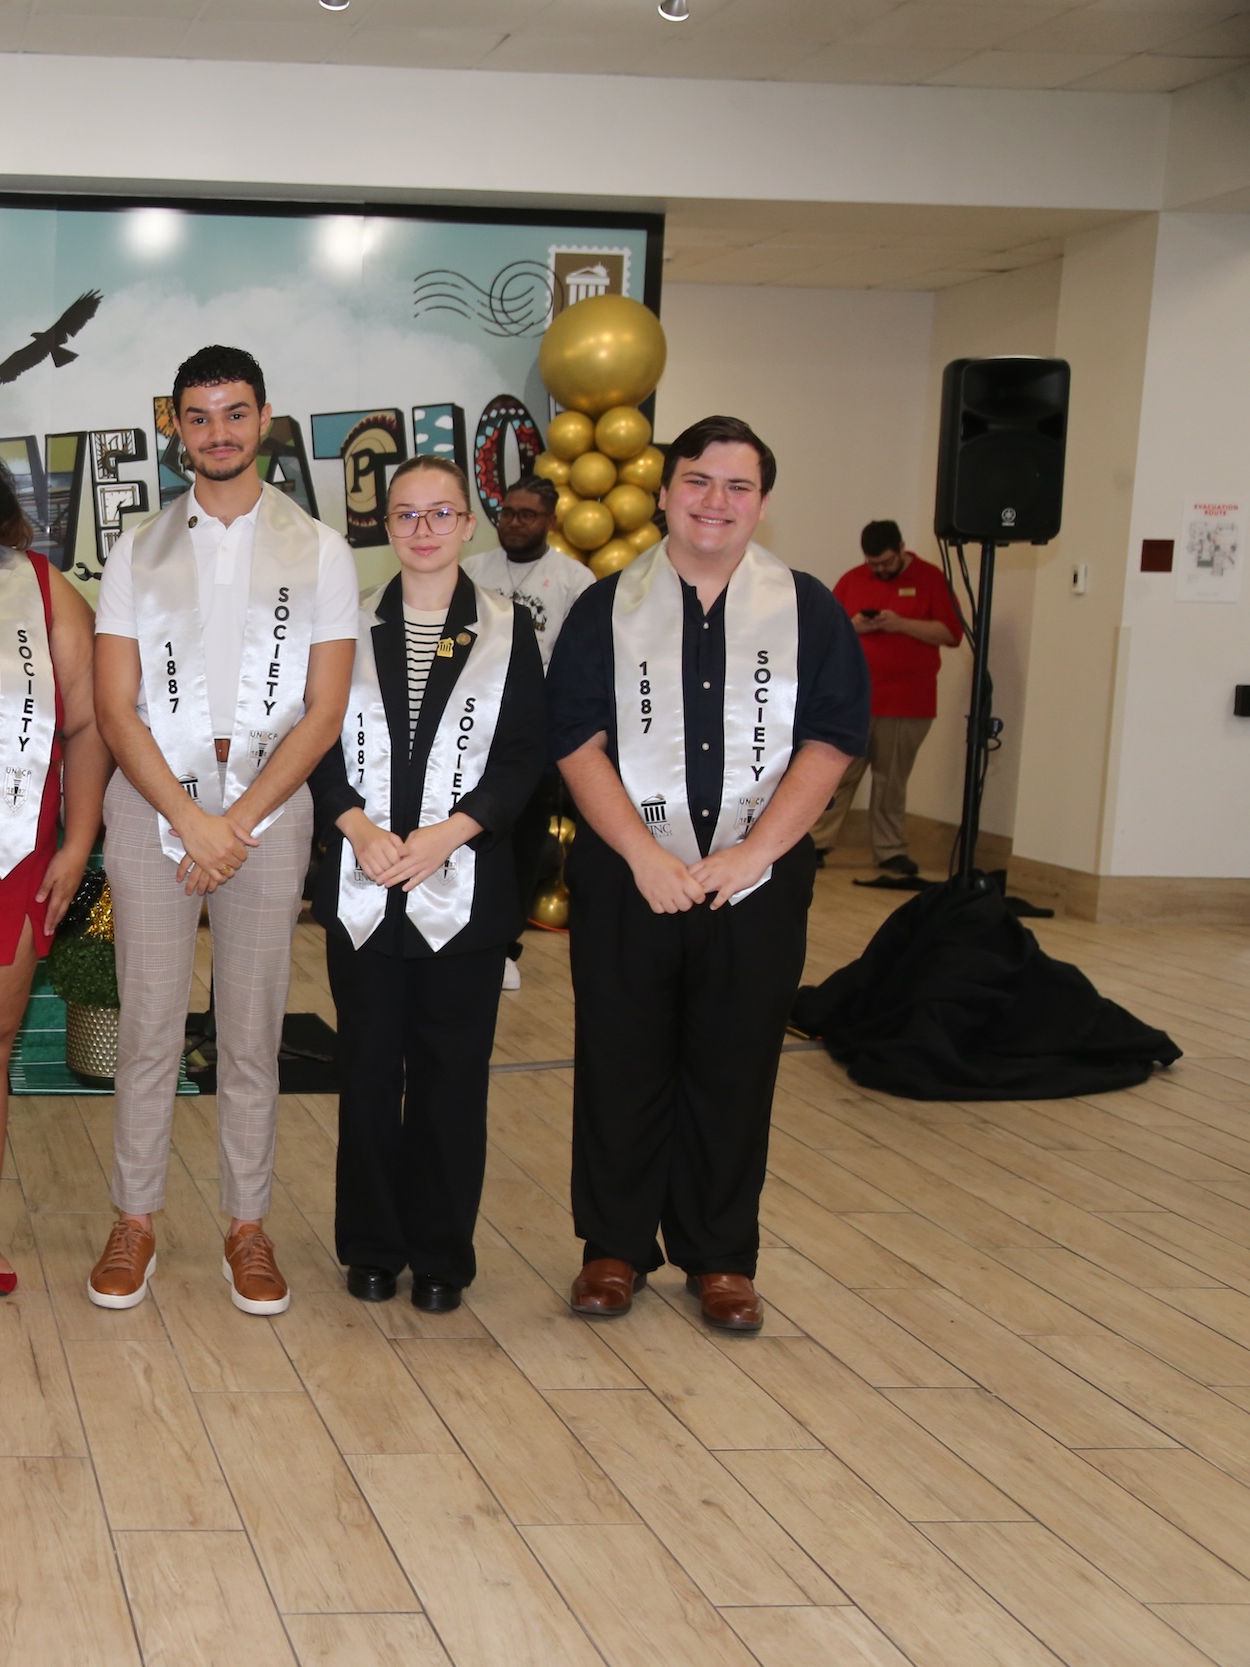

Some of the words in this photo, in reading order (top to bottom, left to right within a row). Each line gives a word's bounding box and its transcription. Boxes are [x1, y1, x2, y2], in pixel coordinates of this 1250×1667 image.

[1193, 503, 1239, 511] EVACUATION
[1204, 509, 1227, 517] ROUTE
[164, 641, 180, 714] 1887
[263, 586, 290, 716] SOCIETY
[16, 629, 36, 753] SOCIETY
[638, 661, 653, 734] 1887
[749, 650, 772, 782] SOCIETY
[356, 712, 365, 784] 1887
[450, 697, 477, 807] SOCIET
[353, 871, 371, 882] UN
